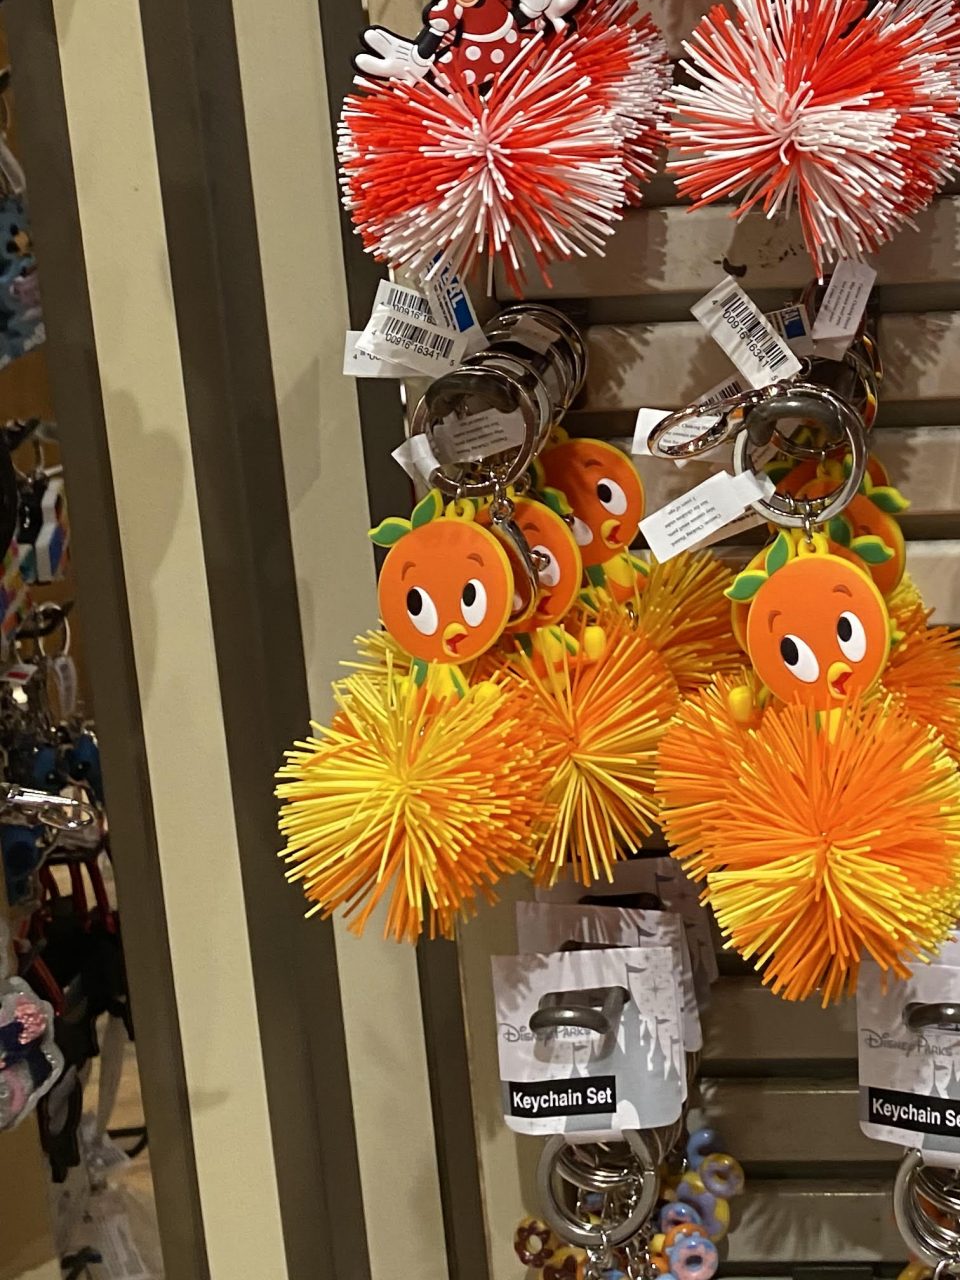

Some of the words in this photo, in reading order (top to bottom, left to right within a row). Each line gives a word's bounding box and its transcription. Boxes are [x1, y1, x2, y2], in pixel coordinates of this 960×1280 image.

[385, 332, 410, 349] 00916
[413, 343, 442, 361] 16341
[721, 309, 748, 341] 00916
[744, 337, 770, 367] 16341
[513, 1089, 582, 1113] Keychain
[586, 1087, 612, 1105] Set
[872, 1098, 941, 1125] Keychain
